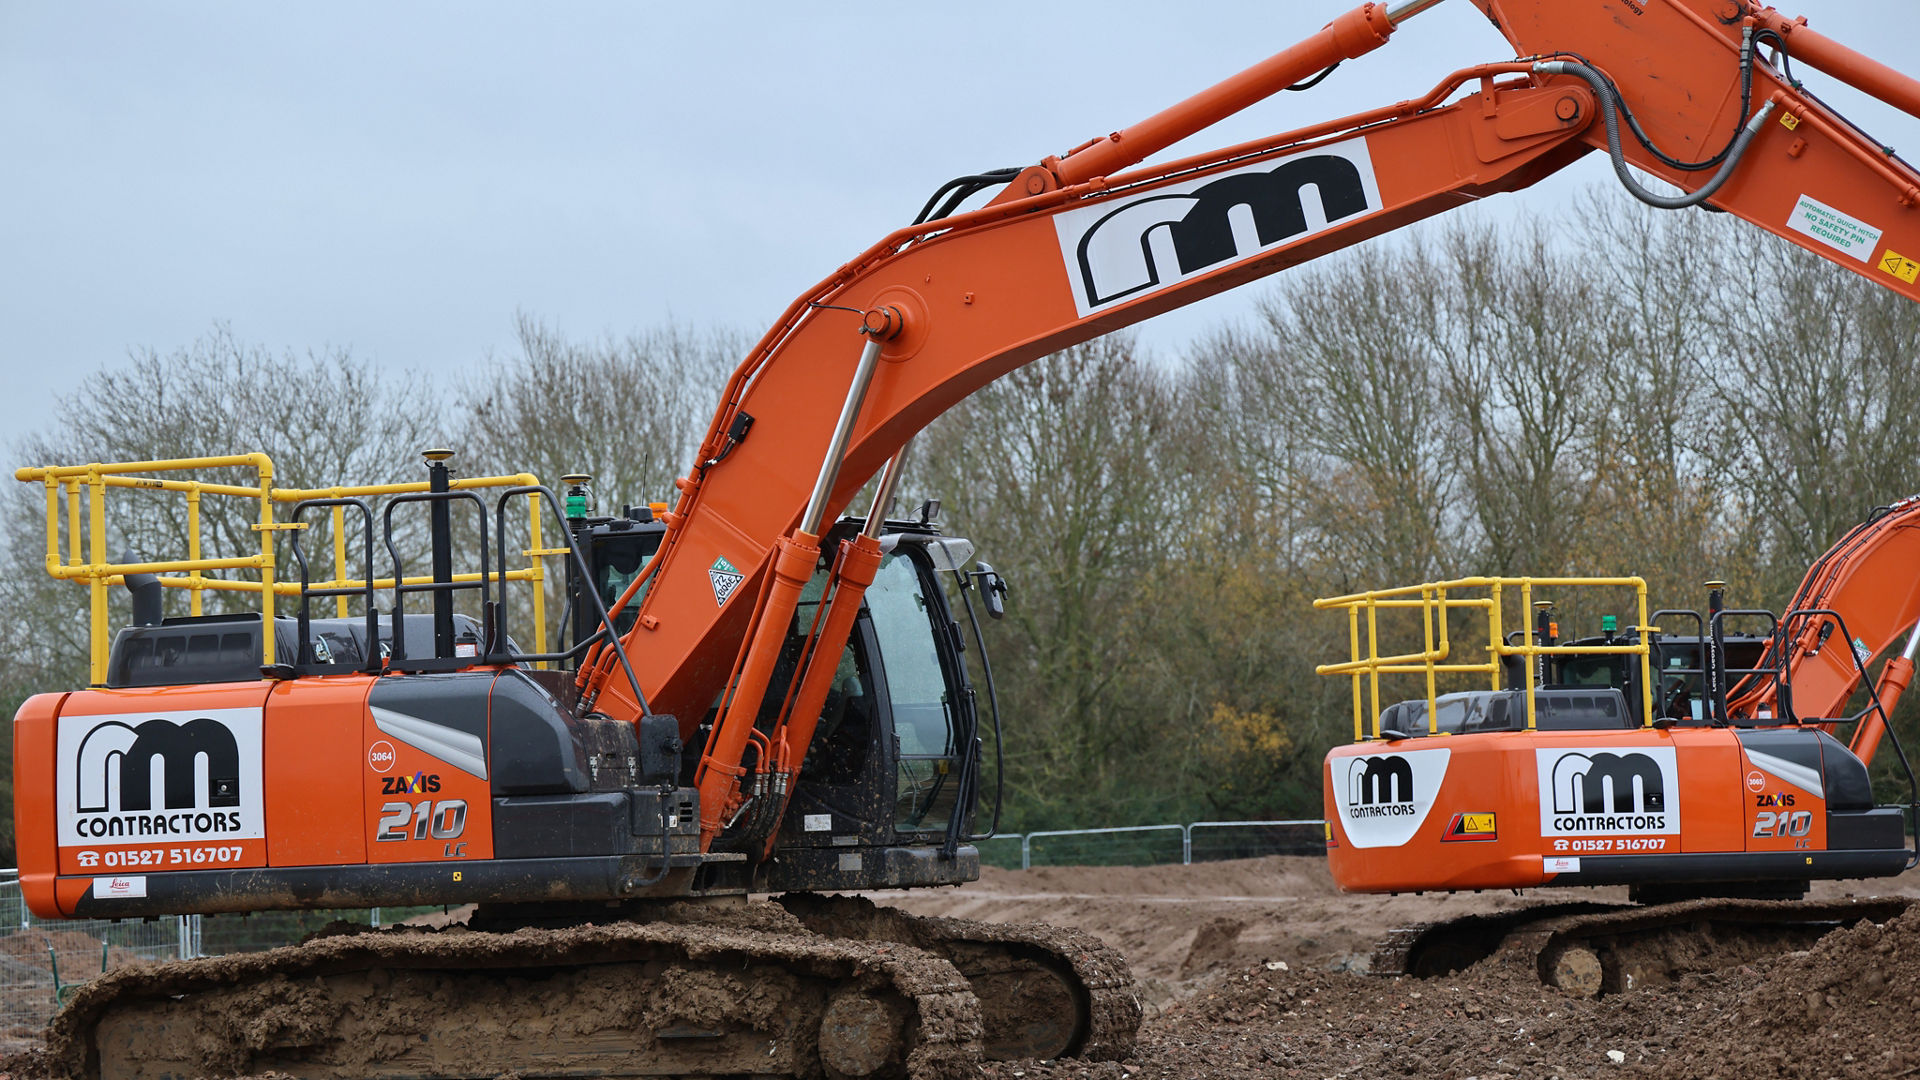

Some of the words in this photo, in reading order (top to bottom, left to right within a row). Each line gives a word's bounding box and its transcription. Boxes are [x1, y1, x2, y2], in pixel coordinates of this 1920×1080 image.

[1621, 0, 1643, 15] ology
[1800, 200, 1836, 220] AUTOMATIC
[1837, 217, 1857, 231] QUICK
[1858, 227, 1878, 240] HITCH
[1804, 212, 1817, 222] NO
[1818, 218, 1850, 236] SAFETY
[1850, 233, 1865, 244] PIN
[1810, 224, 1851, 248] REQUIRED
[715, 575, 726, 586] 72
[372, 752, 392, 762] 3064
[382, 771, 441, 795] ZAXIS
[1756, 792, 1795, 807] ZAXIS
[1350, 804, 1416, 818] CONTRACTORS
[76, 812, 241, 837] CONTRACTORS
[376, 799, 468, 842] 210
[1554, 816, 1665, 831] CONTRACTORS
[1752, 811, 1813, 838] 210
[444, 842, 468, 857] LC
[1572, 840, 1612, 851] 01527
[1616, 839, 1666, 850] 516707
[1795, 838, 1811, 848] LC
[104, 850, 164, 866] 01527
[170, 847, 243, 864] 516707
[109, 877, 130, 889] Leica
